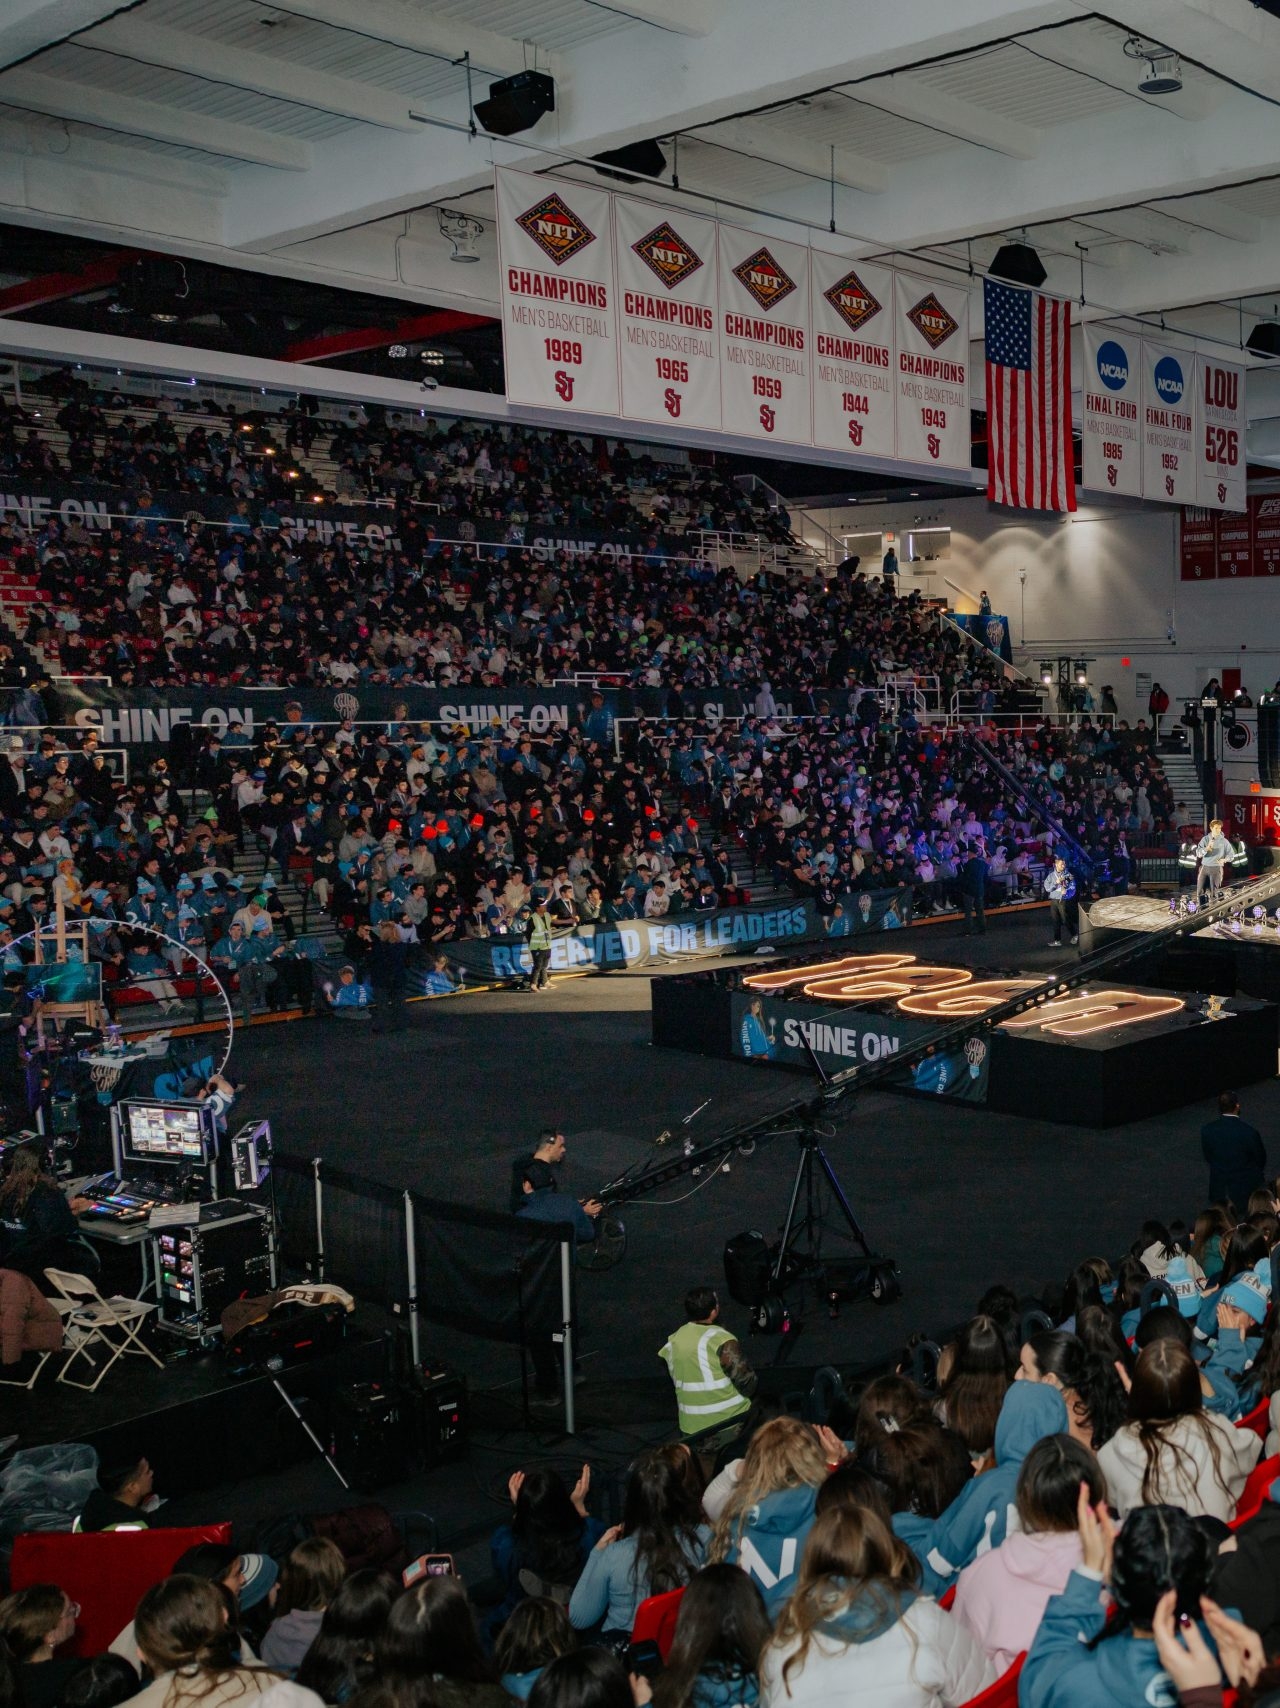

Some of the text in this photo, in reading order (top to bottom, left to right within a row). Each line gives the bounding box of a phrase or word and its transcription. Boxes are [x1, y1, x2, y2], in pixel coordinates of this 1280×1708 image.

[536, 220, 578, 241] NIT
[651, 246, 688, 266] NIT
[508, 269, 606, 308] CHAMPIONS
[750, 270, 782, 290] NIT
[624, 292, 712, 330] CHAMPIONS
[840, 294, 869, 311] NIT
[512, 305, 610, 338] MEN'S BASKETBALL
[726, 314, 804, 350] CHAMPIONS
[920, 314, 946, 330] NIT
[544, 338, 582, 364] 1989
[627, 326, 714, 358] MEN'S BASKETBALL
[817, 334, 888, 367] CHAMPIONS
[656, 358, 688, 383] 1965
[727, 346, 805, 376] MEN'S BASKETBALL
[900, 353, 964, 384] CHAMPIONS
[1100, 363, 1128, 380] NCAA
[752, 376, 782, 400] 1959
[818, 365, 889, 392] MEN'S BASKETBALL
[1158, 378, 1182, 394] NCAA
[1205, 366, 1238, 410] LOU
[842, 392, 869, 414] 1944
[900, 382, 965, 408] MEN'S BASKETBALL
[1086, 394, 1136, 420] FINAL FOUR
[921, 408, 946, 428] 1943
[1146, 408, 1192, 432] FINAL FOUR
[1102, 442, 1122, 460] 1985
[1206, 425, 1238, 466] 526
[1162, 454, 1178, 470] 1952
[60, 498, 108, 530] ON
[280, 516, 358, 547] SHINE
[534, 537, 632, 565] SHINE ON
[74, 706, 254, 742] SHINE ON
[439, 704, 568, 734] SHINE ON
[490, 929, 641, 978] REERVED
[648, 921, 696, 956] FOR
[702, 906, 807, 948] LEADERS
[784, 1018, 900, 1063] SHINE ON
